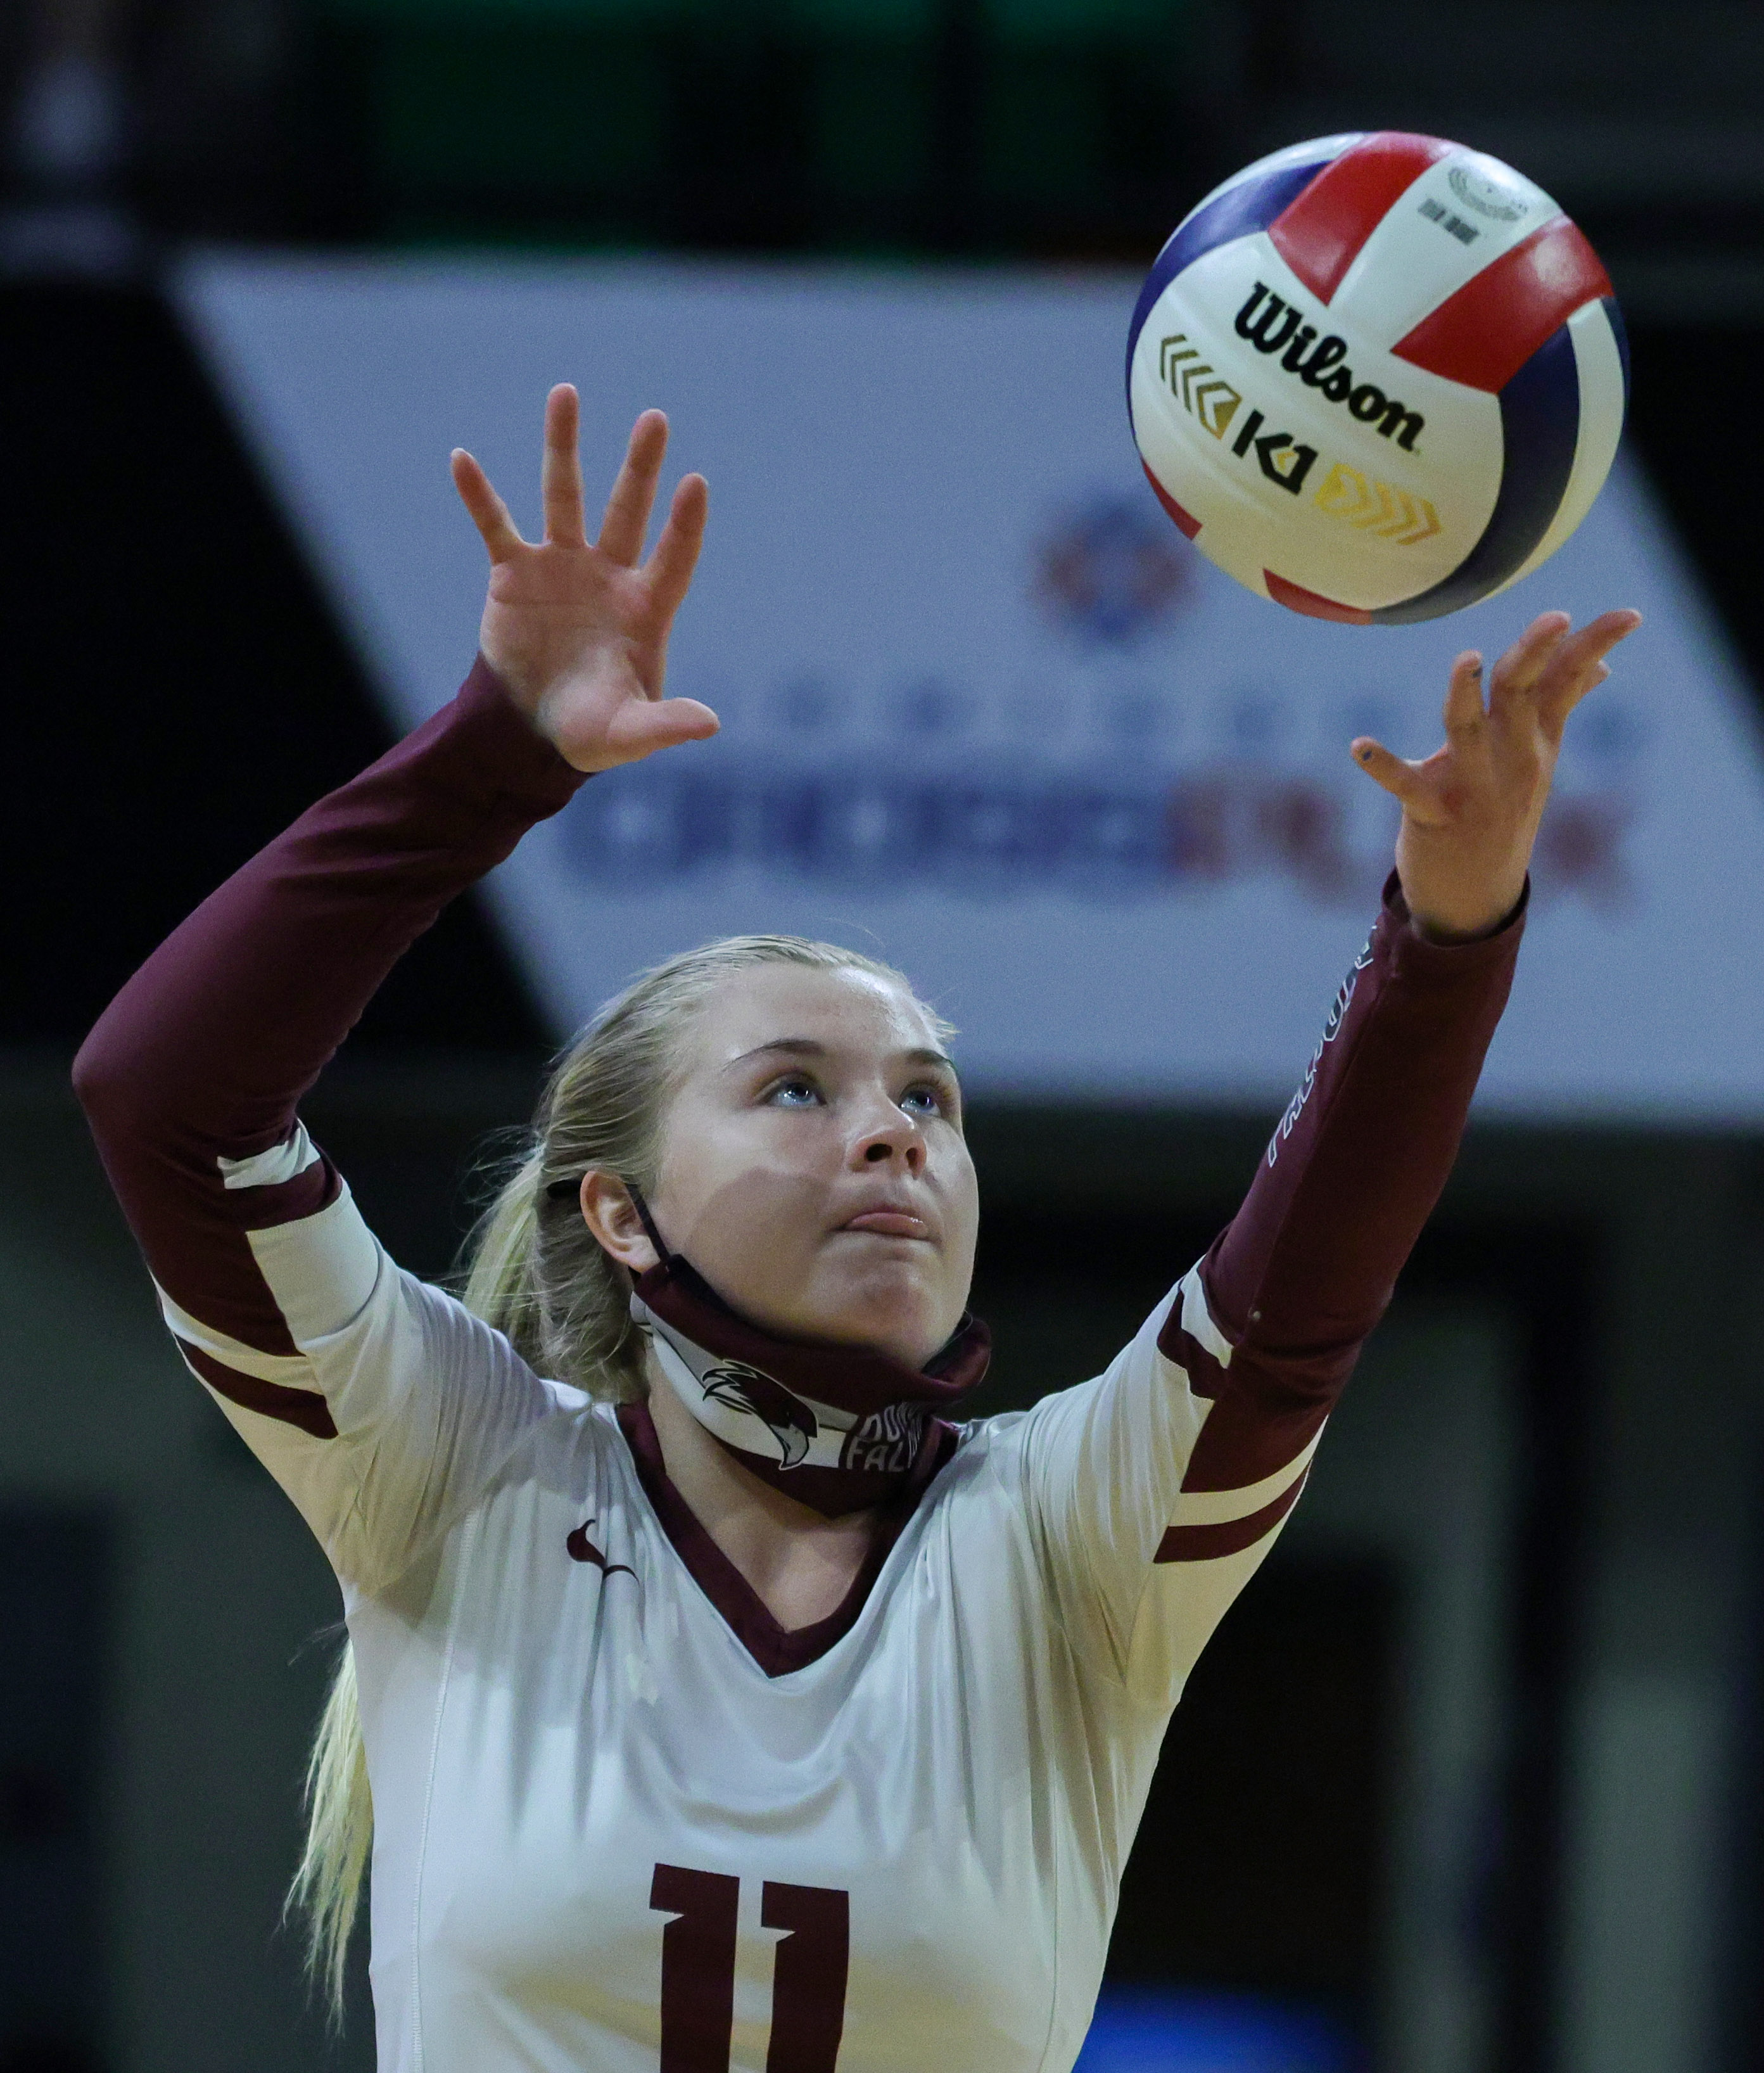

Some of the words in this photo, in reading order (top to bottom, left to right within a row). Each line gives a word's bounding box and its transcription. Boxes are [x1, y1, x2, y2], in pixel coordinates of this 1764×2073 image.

[1234, 280, 1425, 452] Wilson
[1231, 409, 1319, 495] K1
[846, 1435, 917, 1471] FAL
[649, 1863, 849, 2073] 11
